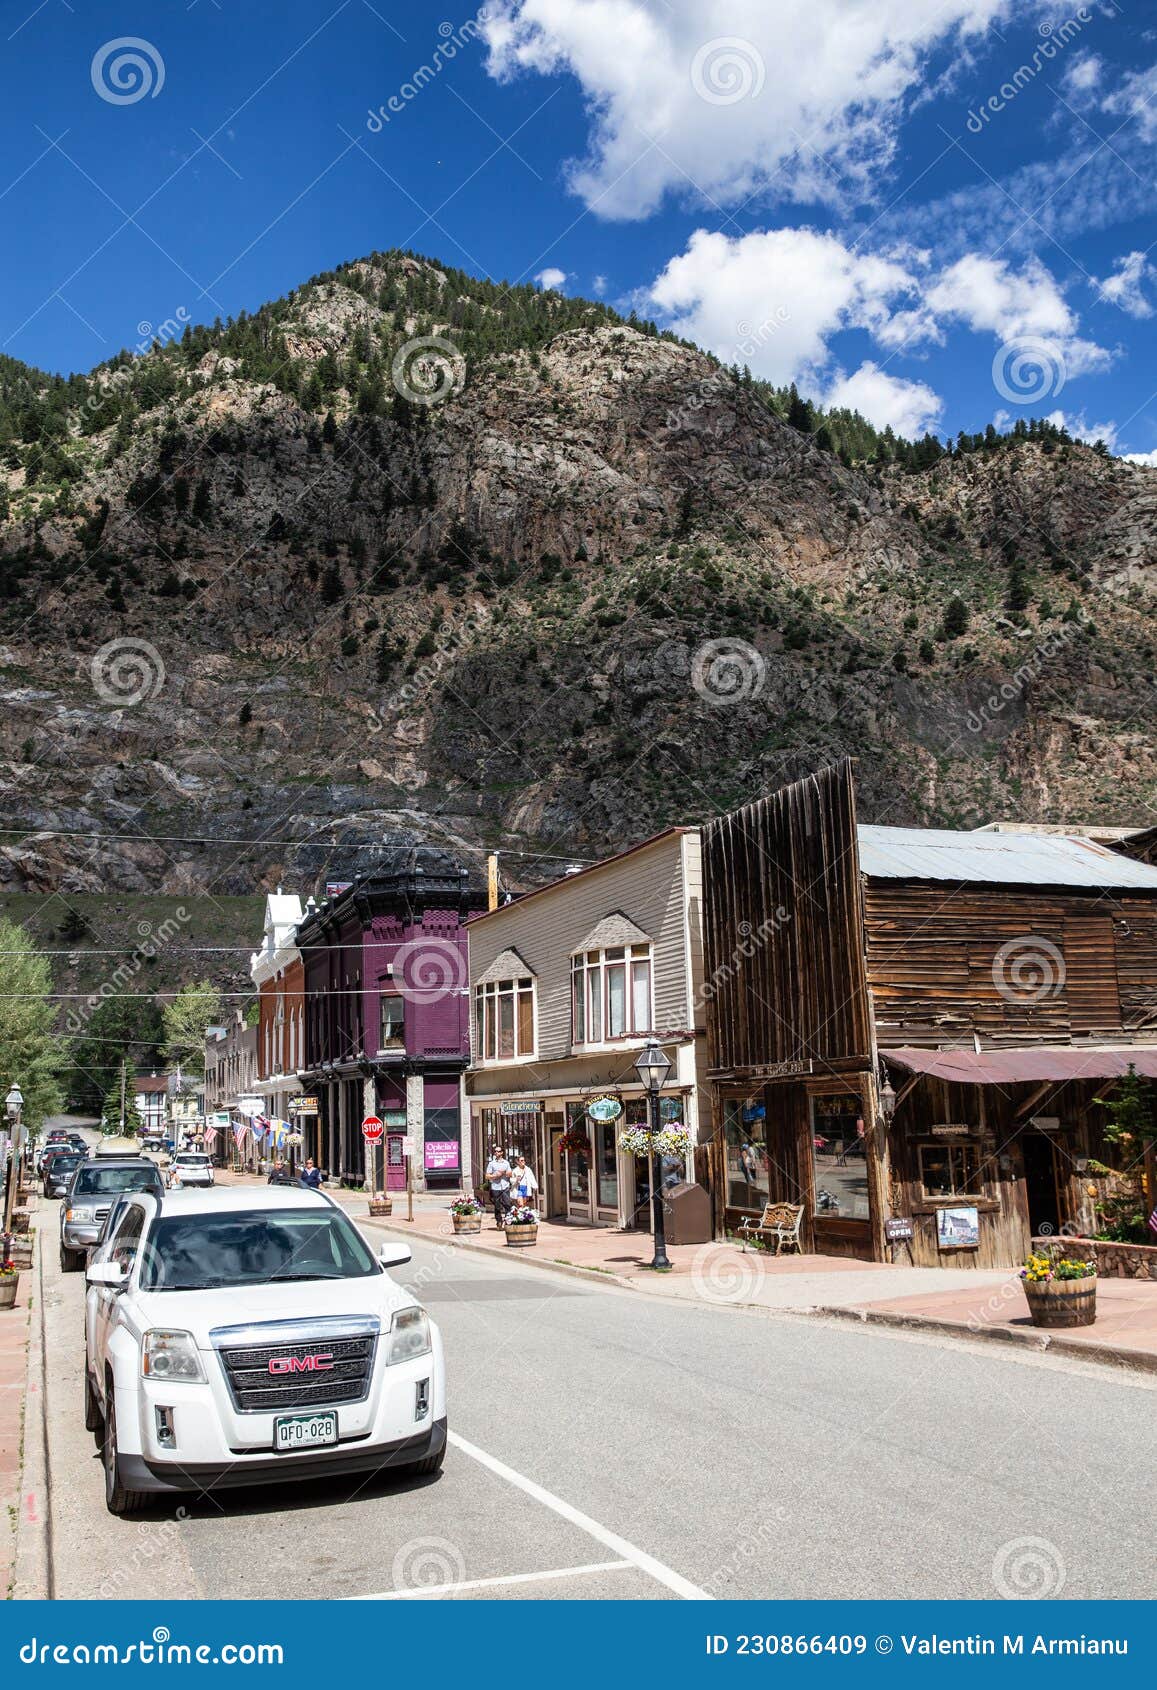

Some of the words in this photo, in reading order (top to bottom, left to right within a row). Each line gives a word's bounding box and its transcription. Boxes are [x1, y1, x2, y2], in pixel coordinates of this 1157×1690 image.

[363, 1123, 382, 1133] STOP
[890, 1228, 912, 1237] OPEN
[269, 1353, 334, 1374] GMC
